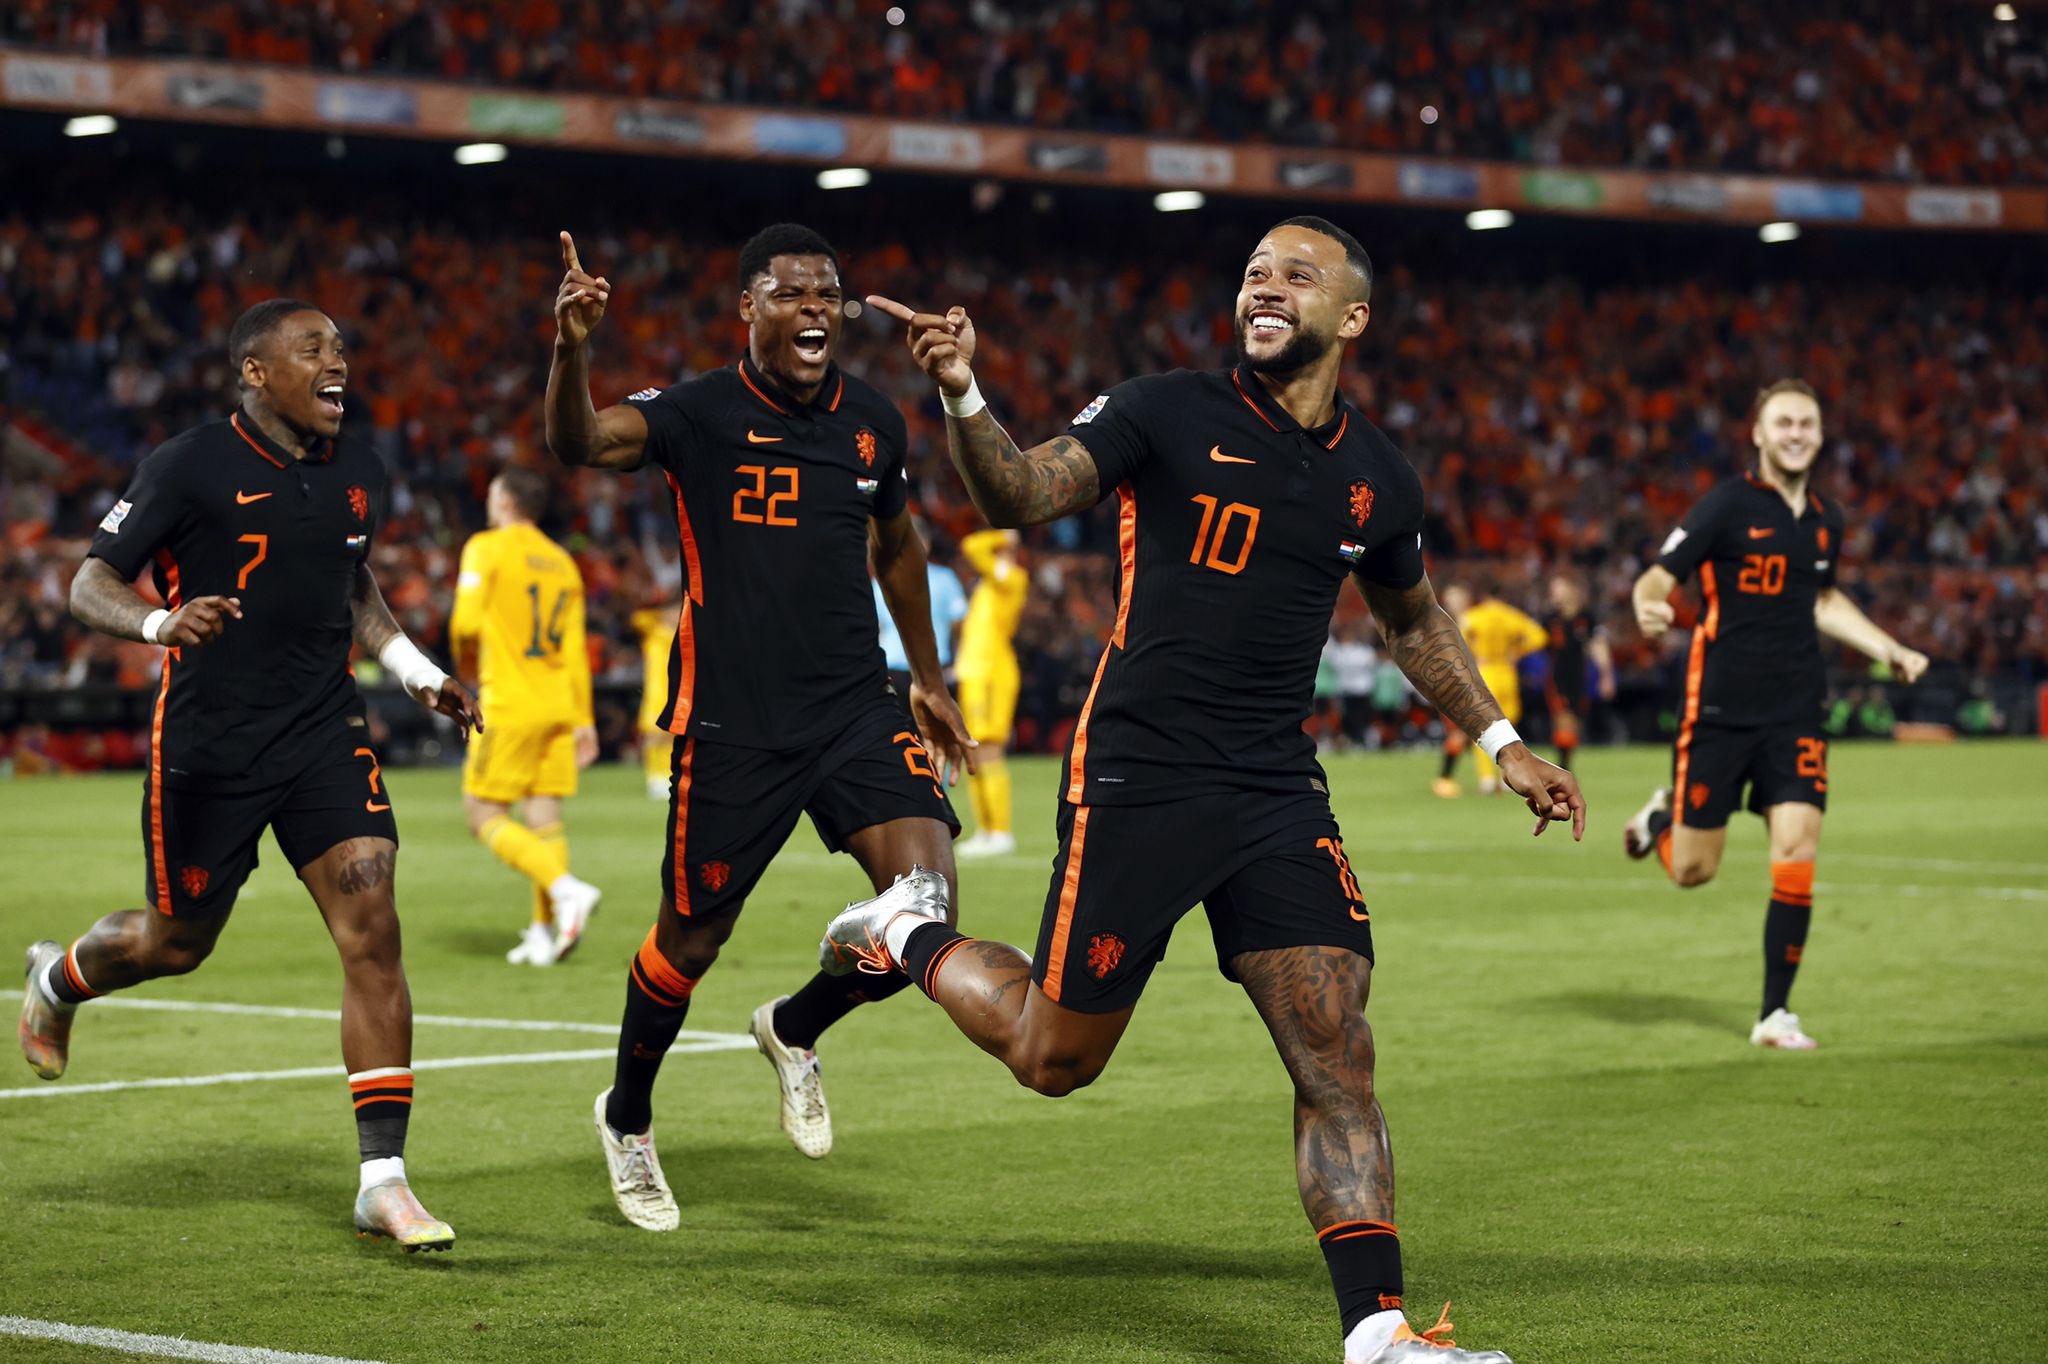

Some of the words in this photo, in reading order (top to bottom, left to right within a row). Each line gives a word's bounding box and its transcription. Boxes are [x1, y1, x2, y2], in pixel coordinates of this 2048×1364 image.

[733, 464, 799, 527] 22
[237, 533, 268, 590] 7
[1189, 493, 1261, 575] 10
[1737, 553, 1787, 595] 20
